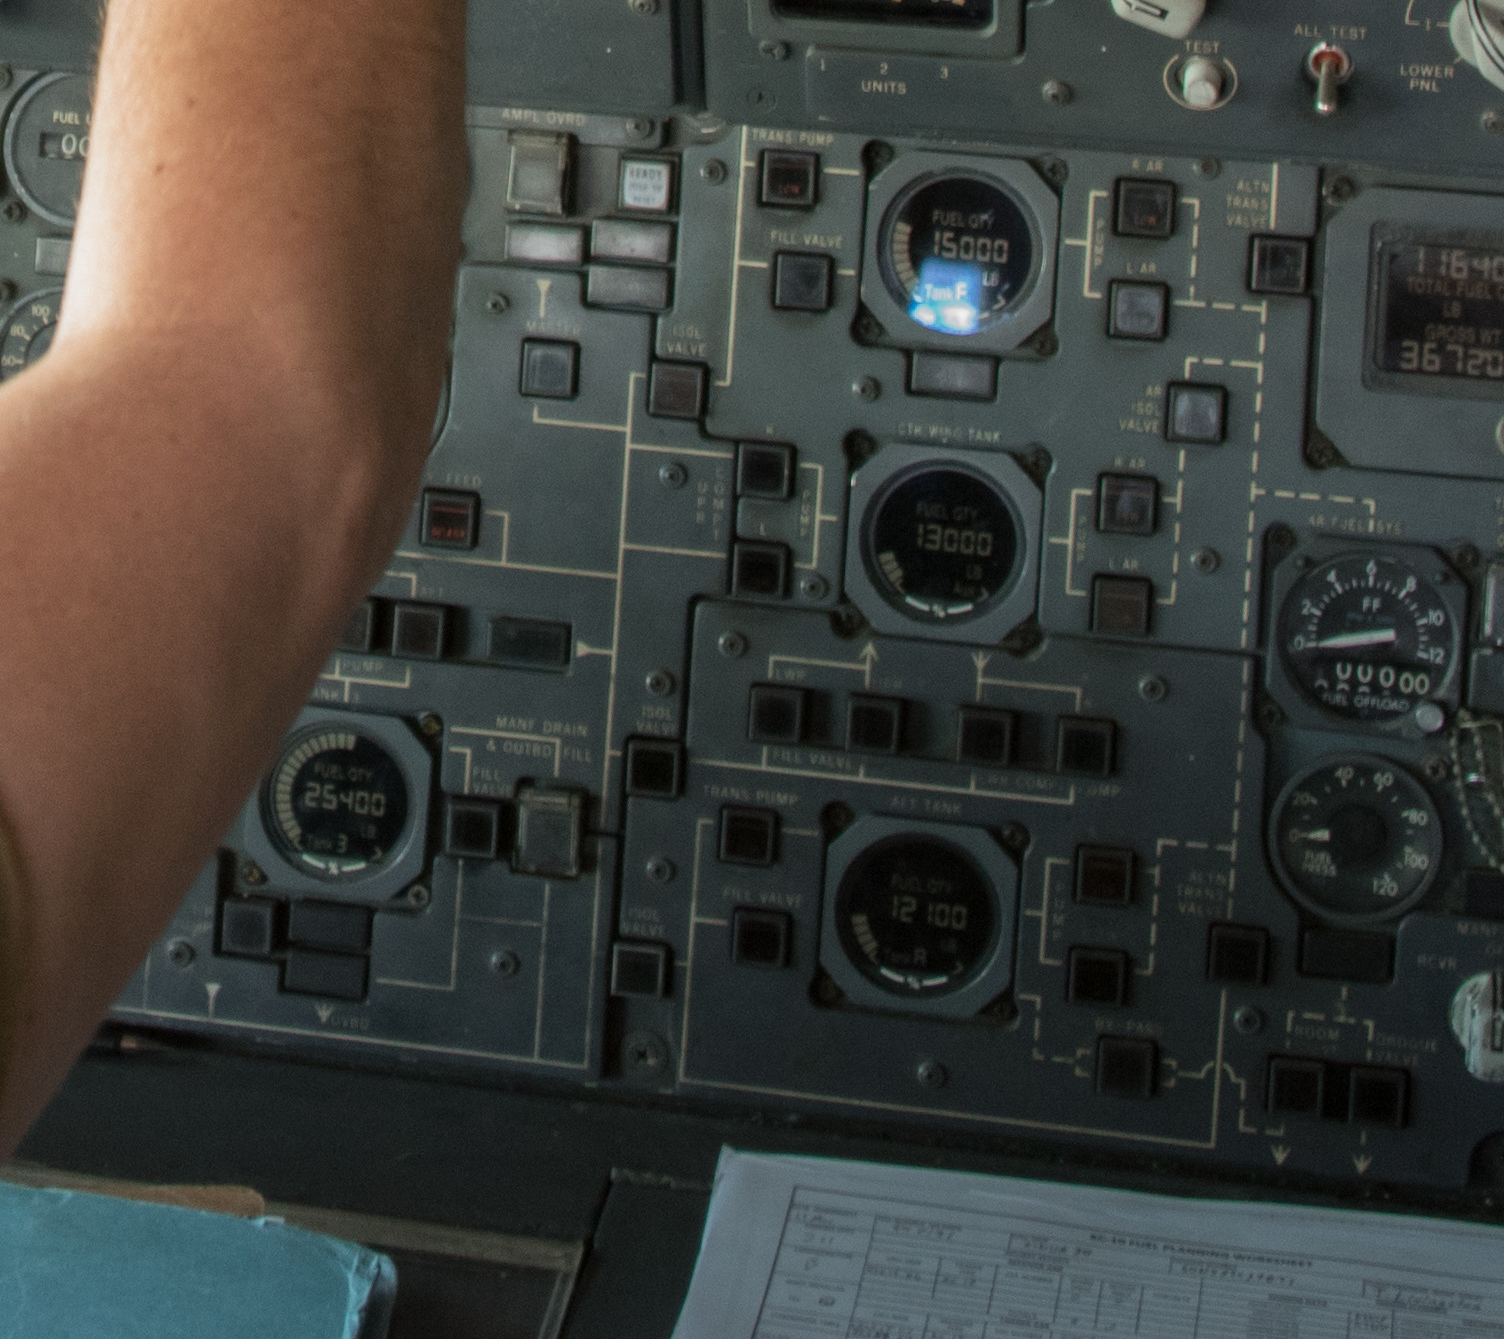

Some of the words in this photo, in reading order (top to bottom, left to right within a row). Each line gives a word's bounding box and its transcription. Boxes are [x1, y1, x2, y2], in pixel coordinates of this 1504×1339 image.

[1294, 23, 1323, 38] ALL
[1328, 25, 1367, 41] TEST
[1400, 64, 1455, 81] LOWER
[862, 80, 906, 93] UNITS
[304, 785, 385, 816] 25400
